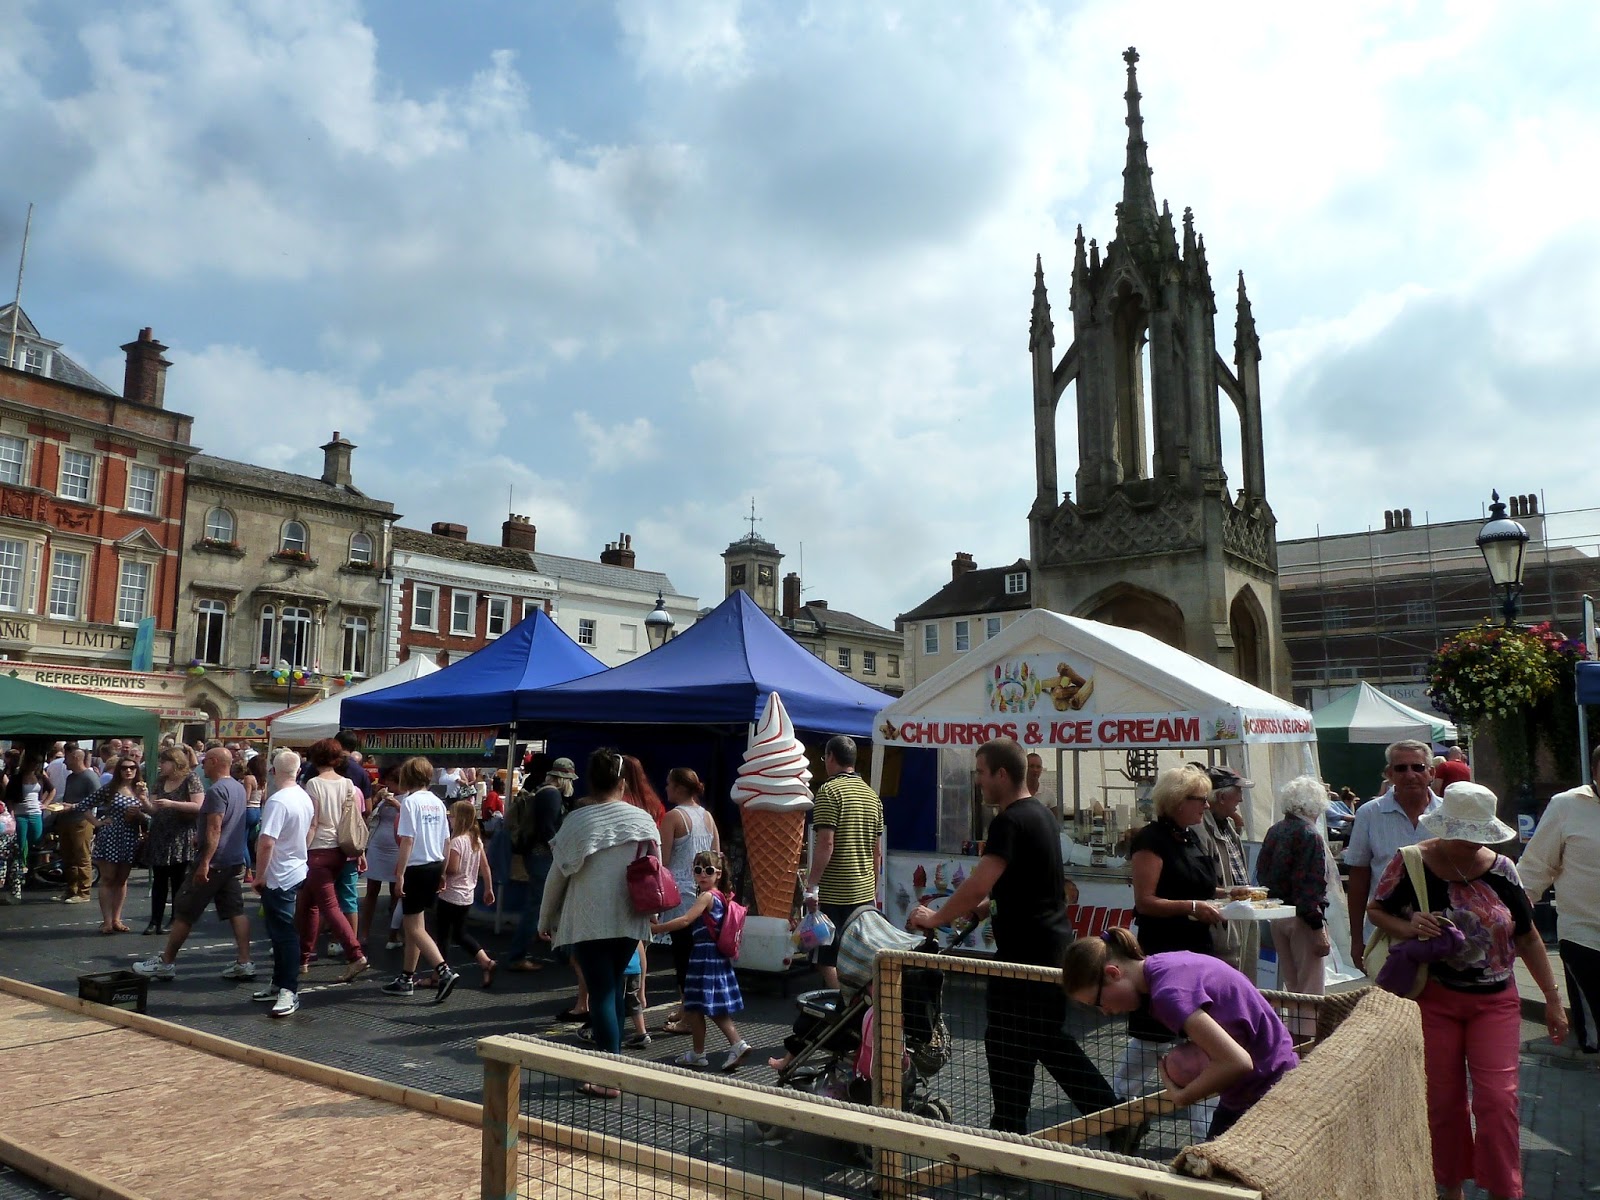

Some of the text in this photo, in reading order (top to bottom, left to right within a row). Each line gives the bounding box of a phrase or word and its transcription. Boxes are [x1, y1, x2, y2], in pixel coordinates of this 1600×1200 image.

[63, 630, 136, 650] LIMITE
[35, 671, 146, 688] REFRESHMENTS
[1388, 688, 1420, 698] HSBC
[900, 717, 1201, 745] CHURROS & ICE CREAM
[1282, 719, 1292, 733] ICE
[1518, 814, 1535, 837] P
